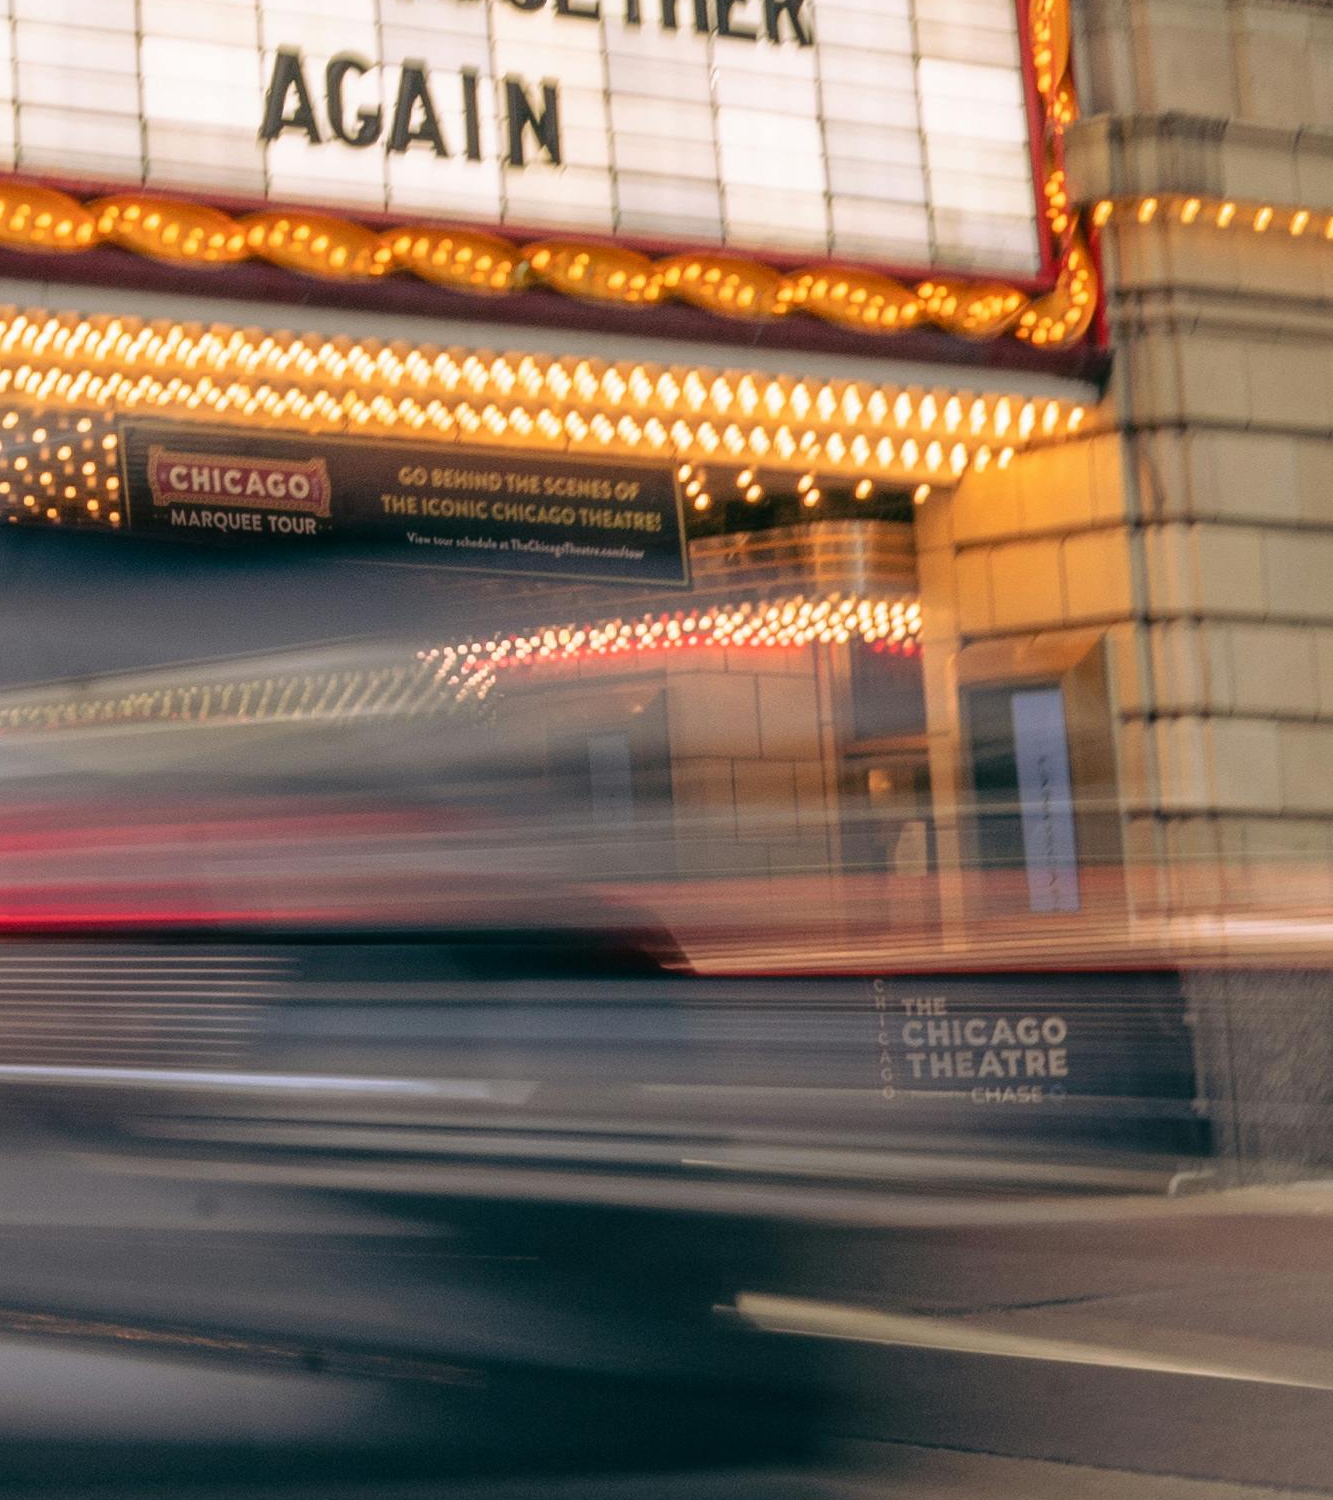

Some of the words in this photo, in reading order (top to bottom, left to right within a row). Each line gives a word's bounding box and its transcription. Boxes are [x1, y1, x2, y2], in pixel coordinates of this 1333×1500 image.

[263, 46, 565, 166] AGAIN
[169, 464, 311, 500] CHICAGO
[398, 465, 428, 487] GO
[432, 468, 502, 492] BEHIND
[506, 474, 540, 494] THE
[543, 475, 612, 499] SCENES
[171, 508, 263, 533] MARQUEE
[267, 515, 317, 535] TOUR
[381, 494, 417, 515] THE
[422, 497, 488, 520] ICONIC
[491, 503, 577, 527] CHICAGO
[406, 532, 431, 544] View
[901, 996, 947, 1016] THE
[873, 978, 895, 1100] CHICAGO
[901, 1016, 1068, 1046] CHICAGO
[905, 1048, 1069, 1078] THEATRE
[971, 1085, 1042, 1104] CHASE
